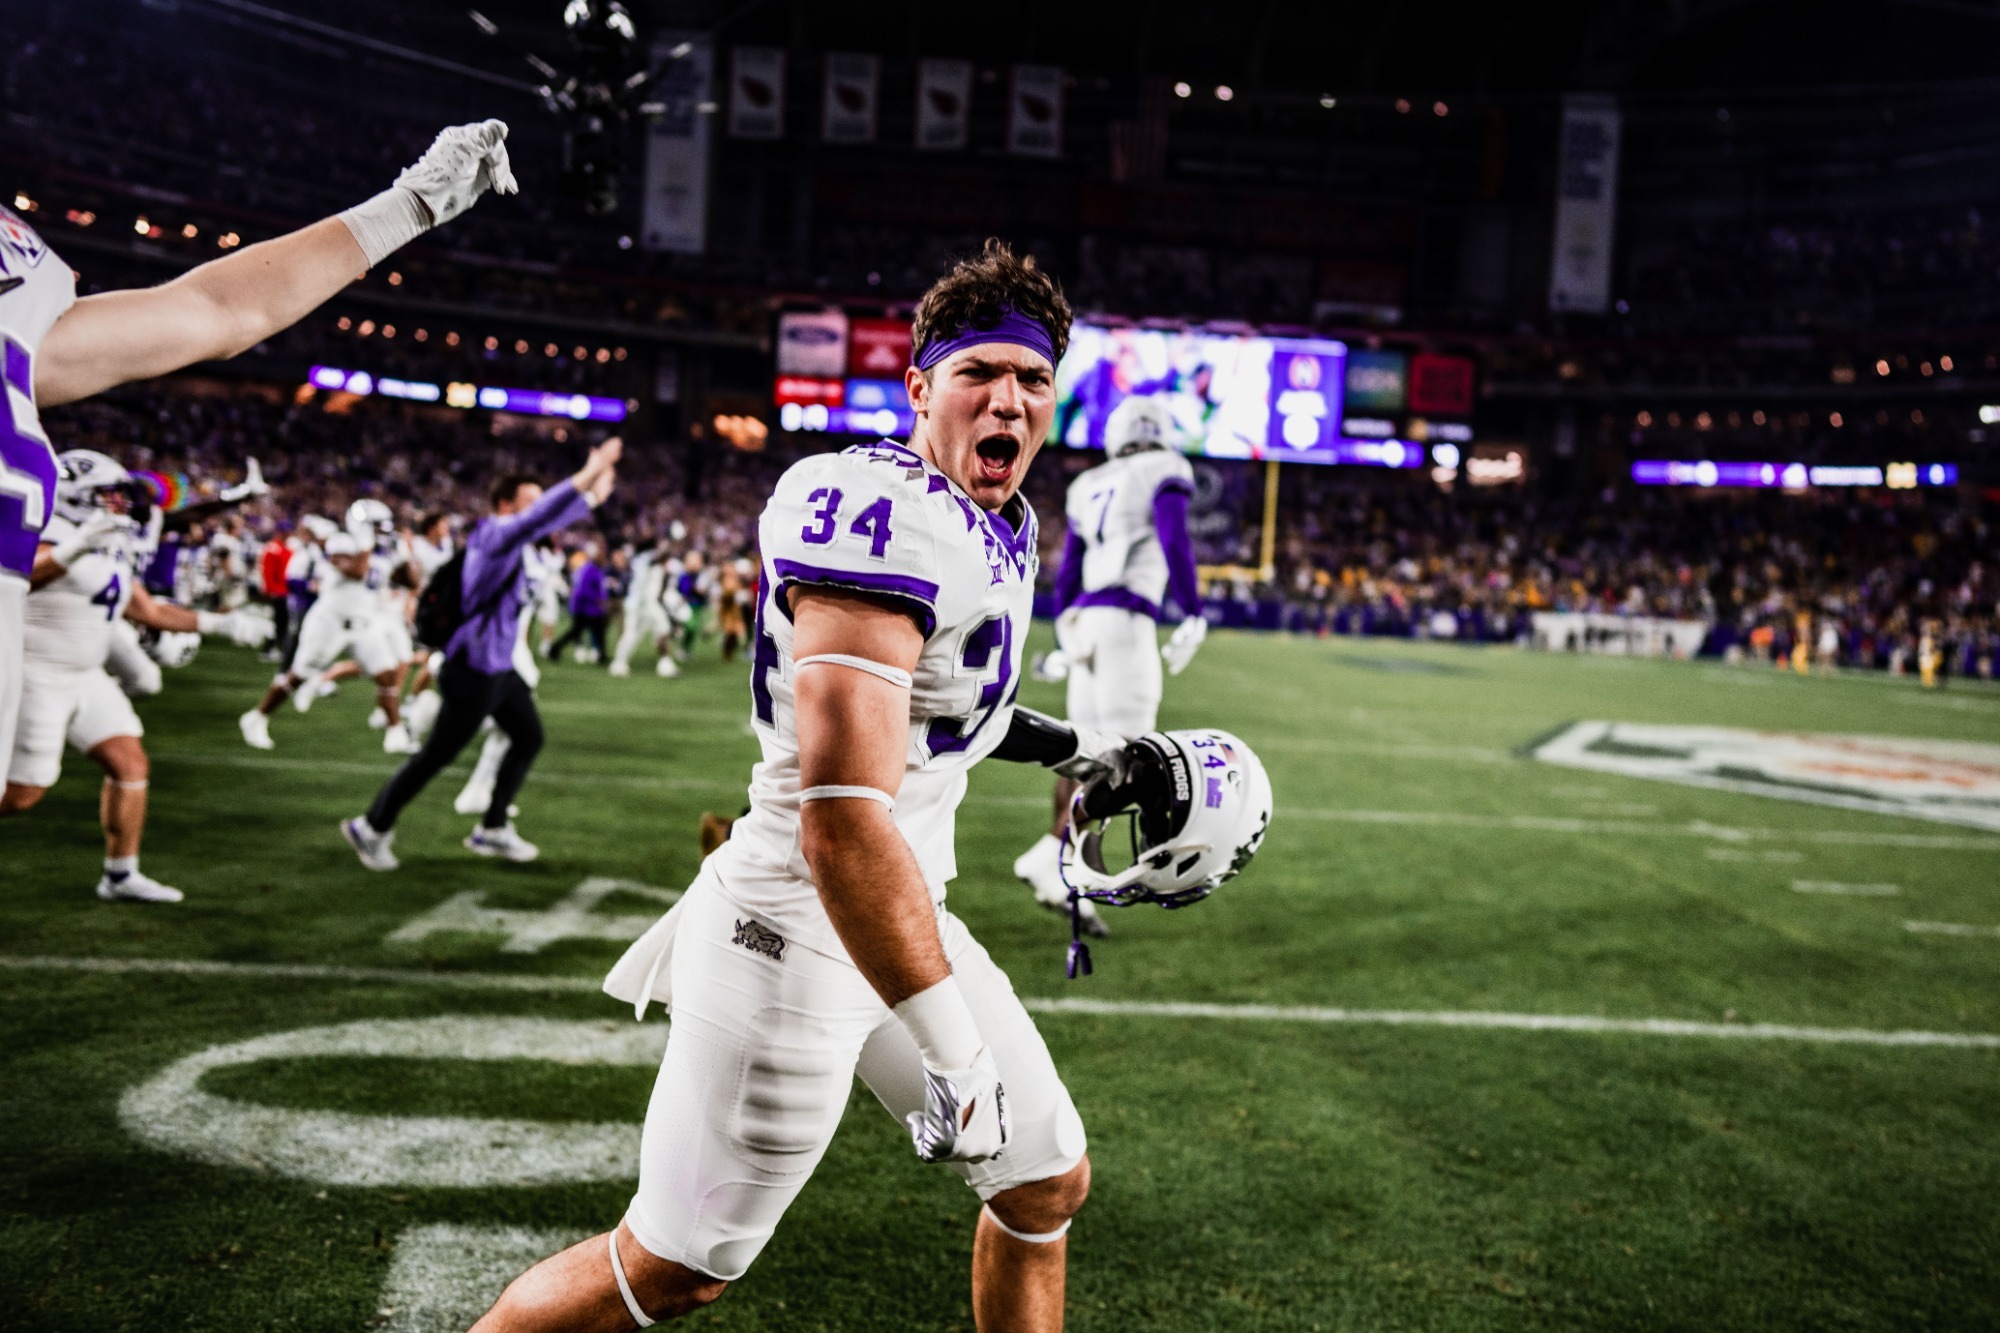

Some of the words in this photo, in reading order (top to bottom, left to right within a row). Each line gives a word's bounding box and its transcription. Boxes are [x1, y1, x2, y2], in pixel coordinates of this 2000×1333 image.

[800, 486, 894, 560] 34
[1091, 488, 1115, 545] 7
[91, 573, 121, 622] 4
[1191, 738, 1227, 769] 34
[1169, 756, 1190, 802] FROGS
